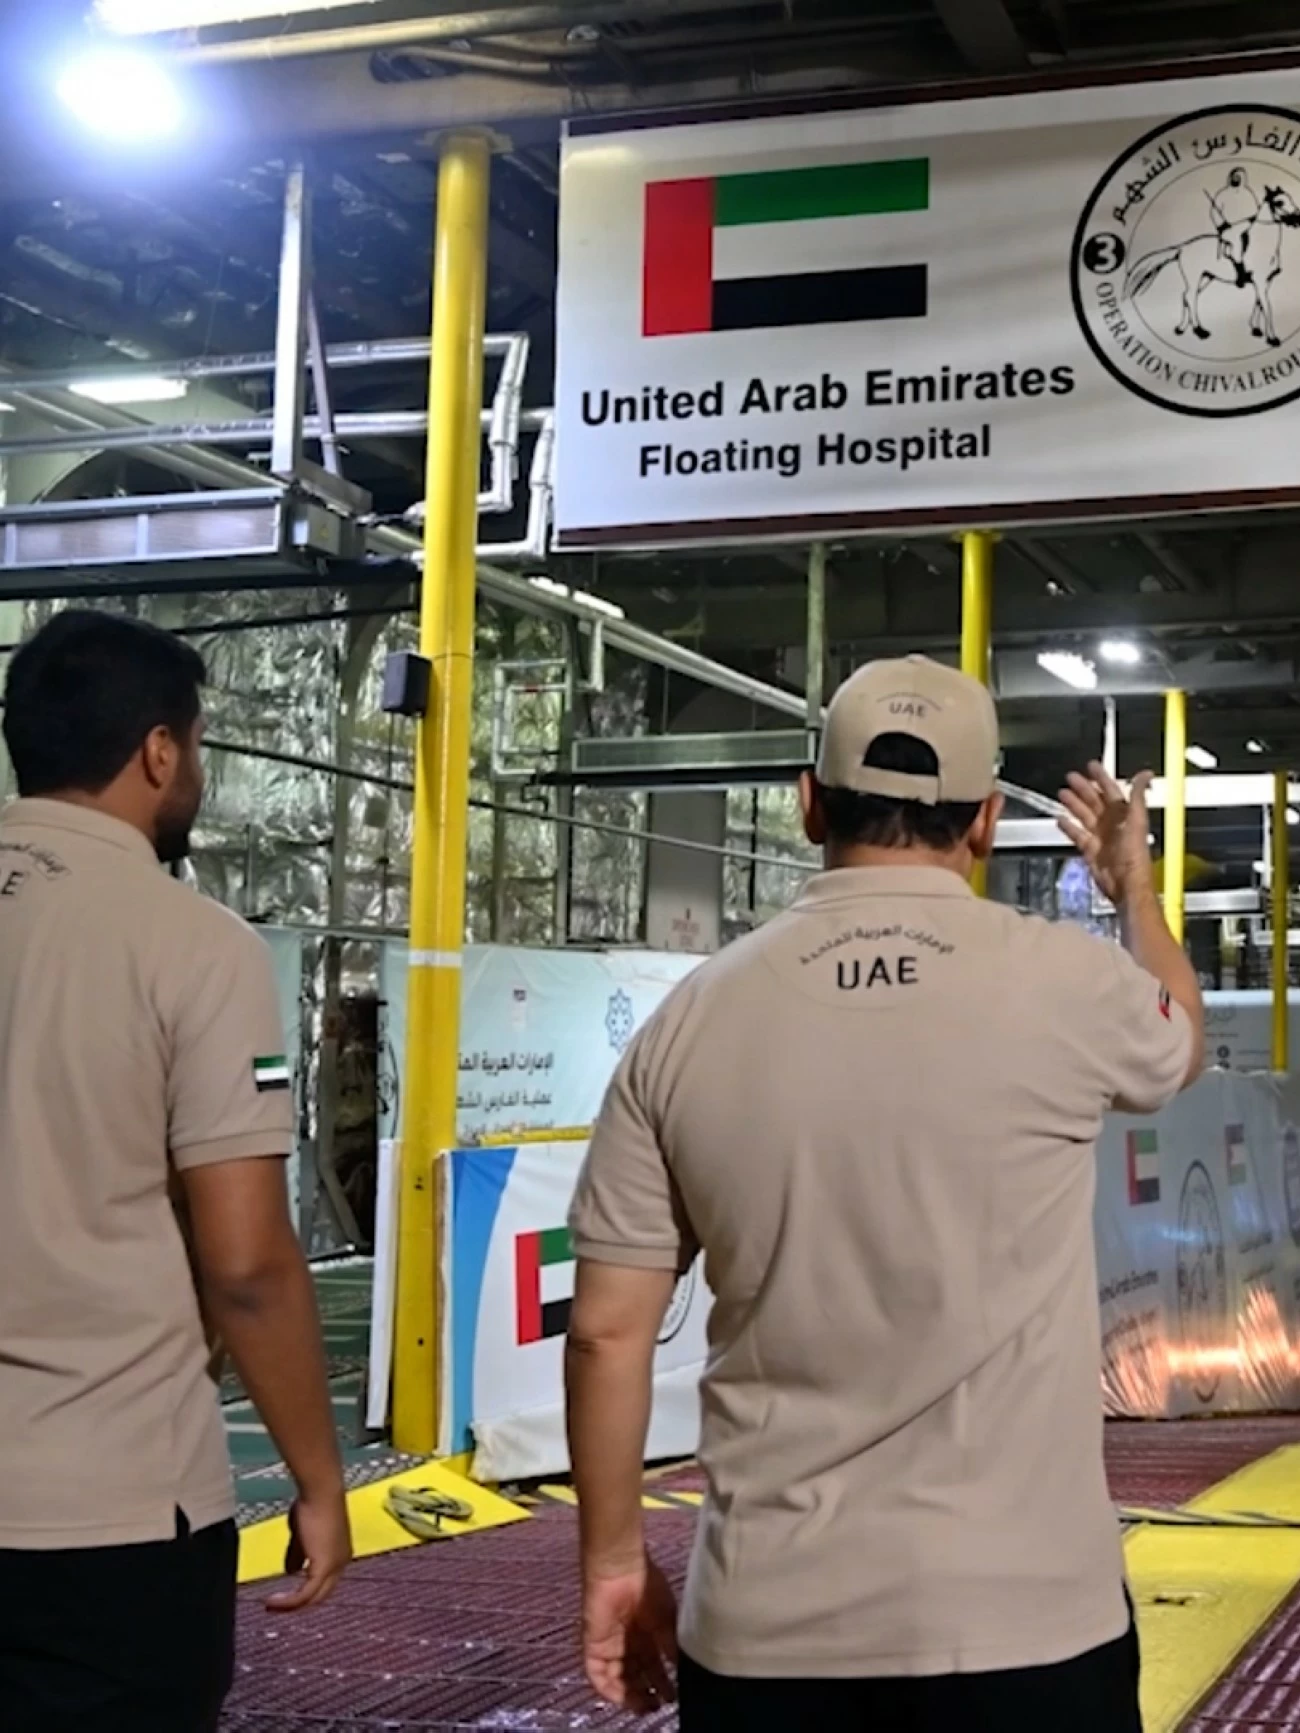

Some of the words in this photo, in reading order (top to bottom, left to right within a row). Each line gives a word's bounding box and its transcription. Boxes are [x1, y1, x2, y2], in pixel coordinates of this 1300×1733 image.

[1112, 141, 1181, 226] الشهم
[1095, 281, 1174, 386] OPERATION
[581, 381, 724, 427] United
[740, 374, 848, 416] Arab
[865, 362, 1076, 407] Emirates
[639, 438, 801, 478] Floating
[817, 424, 991, 471] Hospital
[889, 701, 928, 718] UAE
[836, 955, 920, 991] UAE
